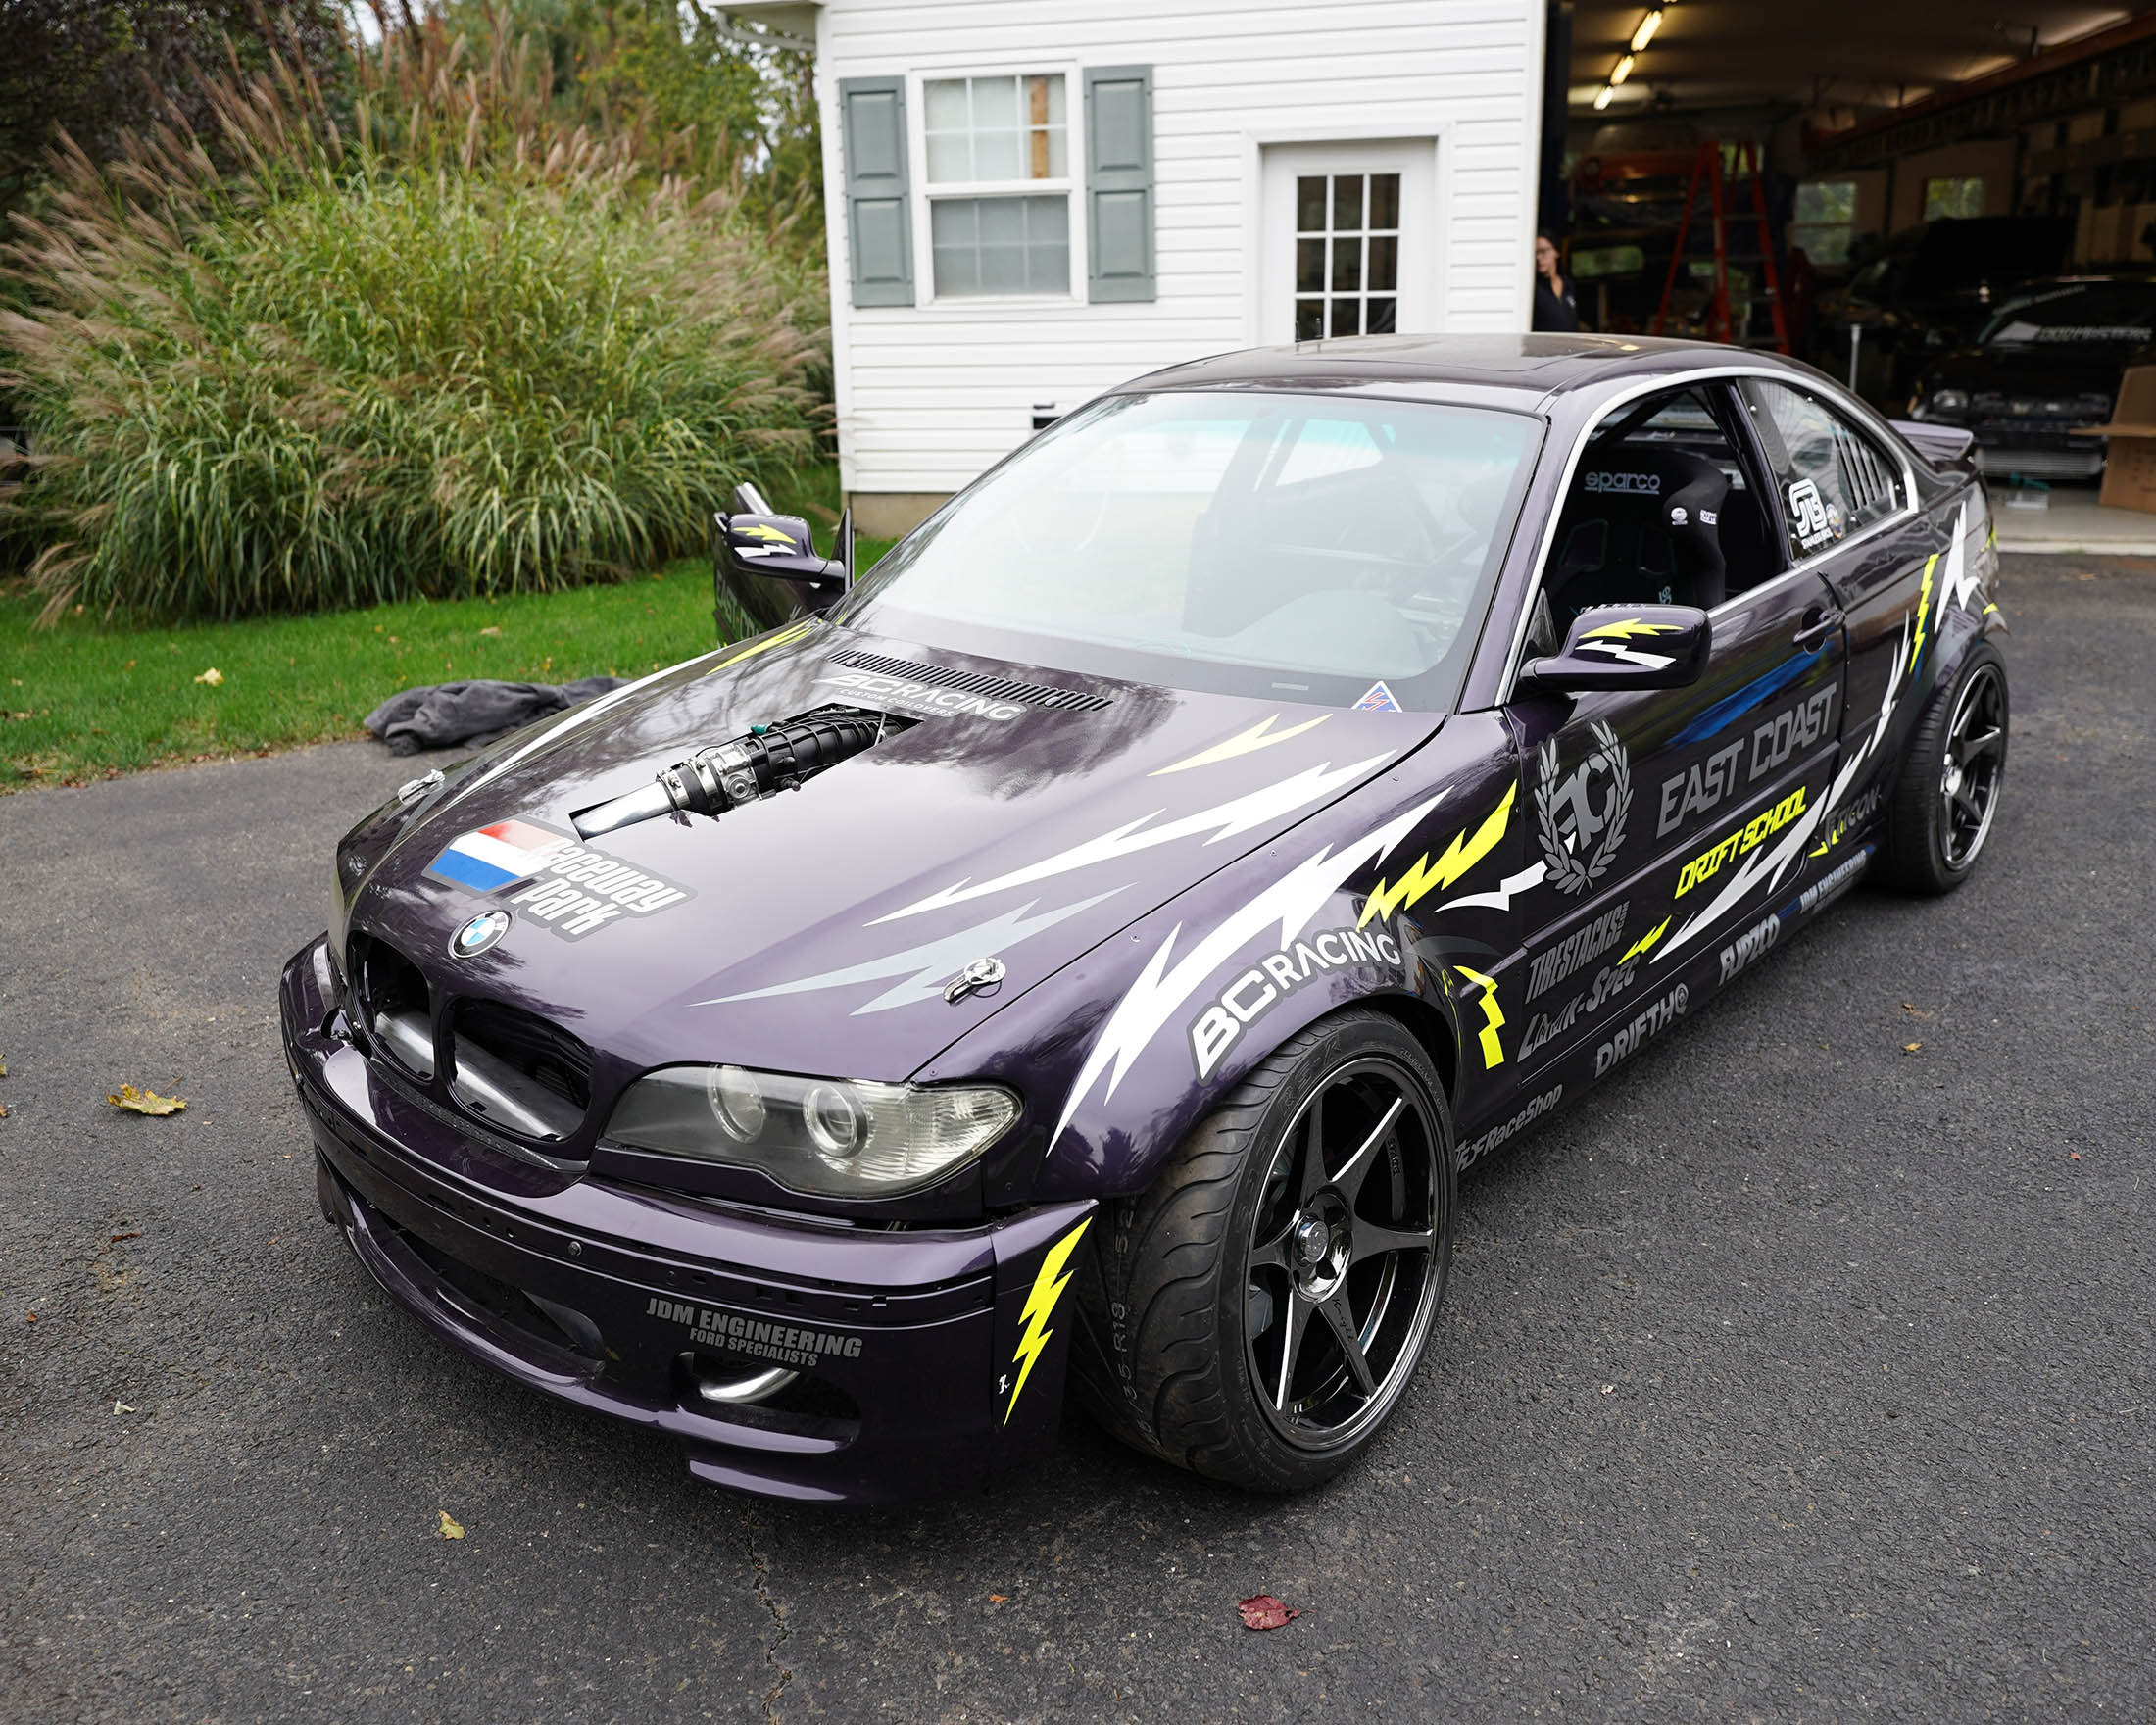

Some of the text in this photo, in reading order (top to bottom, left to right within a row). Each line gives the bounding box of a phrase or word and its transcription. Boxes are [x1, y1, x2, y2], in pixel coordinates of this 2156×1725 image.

[1585, 471, 1661, 493] sparco
[1656, 682, 1838, 839] EAST COAST
[1674, 829, 1744, 900] DRIFT
[1740, 786, 1807, 855] SCHOOL
[510, 877, 622, 935] Park
[1594, 983, 1690, 1079] DRIFTHQ
[646, 1297, 863, 1358] JDM ENGINEERING
[689, 1327, 819, 1367] FORD SPECIALISTS
